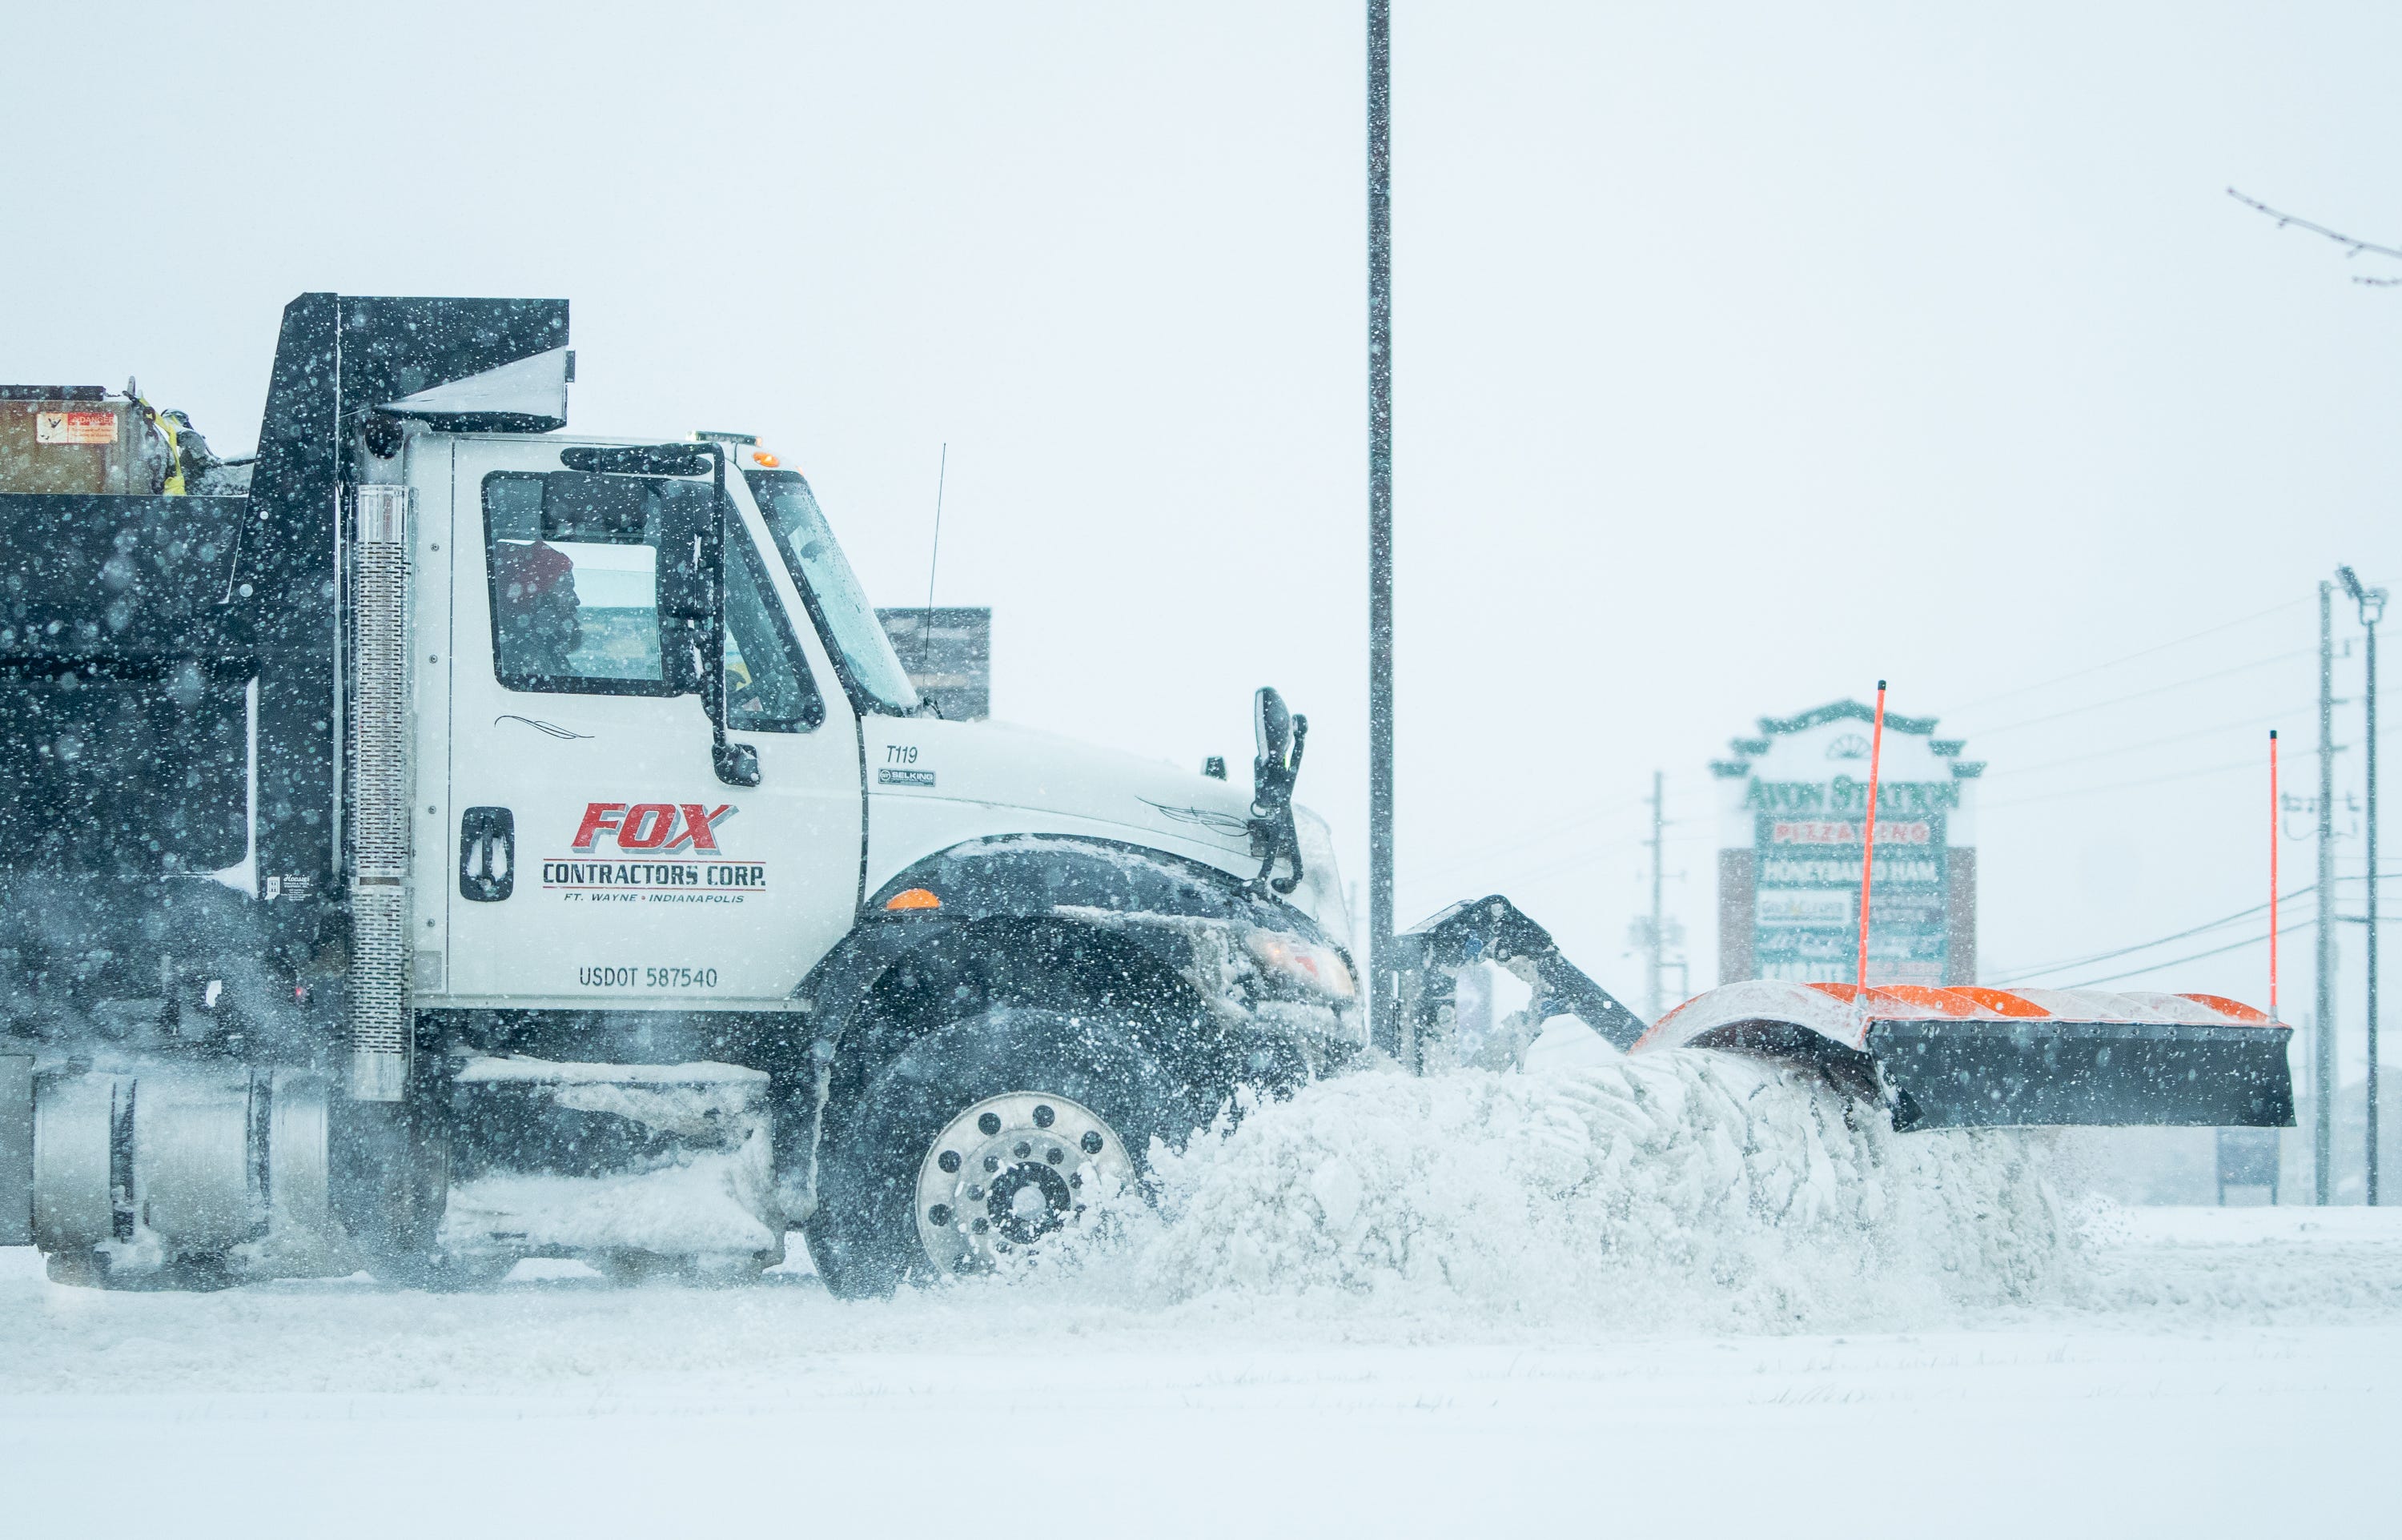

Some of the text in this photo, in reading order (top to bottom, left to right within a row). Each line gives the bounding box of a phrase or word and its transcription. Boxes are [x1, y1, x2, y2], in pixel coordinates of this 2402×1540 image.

[886, 744, 918, 764] T119
[892, 772, 934, 780] SELKING
[571, 802, 739, 855] FOX
[1774, 821, 1854, 843] PIZZA
[283, 874, 311, 882] Hoosier
[543, 863, 766, 886] CONTRACTORS CORP.
[1890, 861, 1936, 881] HAM
[564, 892, 745, 904] FT. WAYNE INDIANAPOLIS
[580, 966, 718, 988] USDOT 587540
